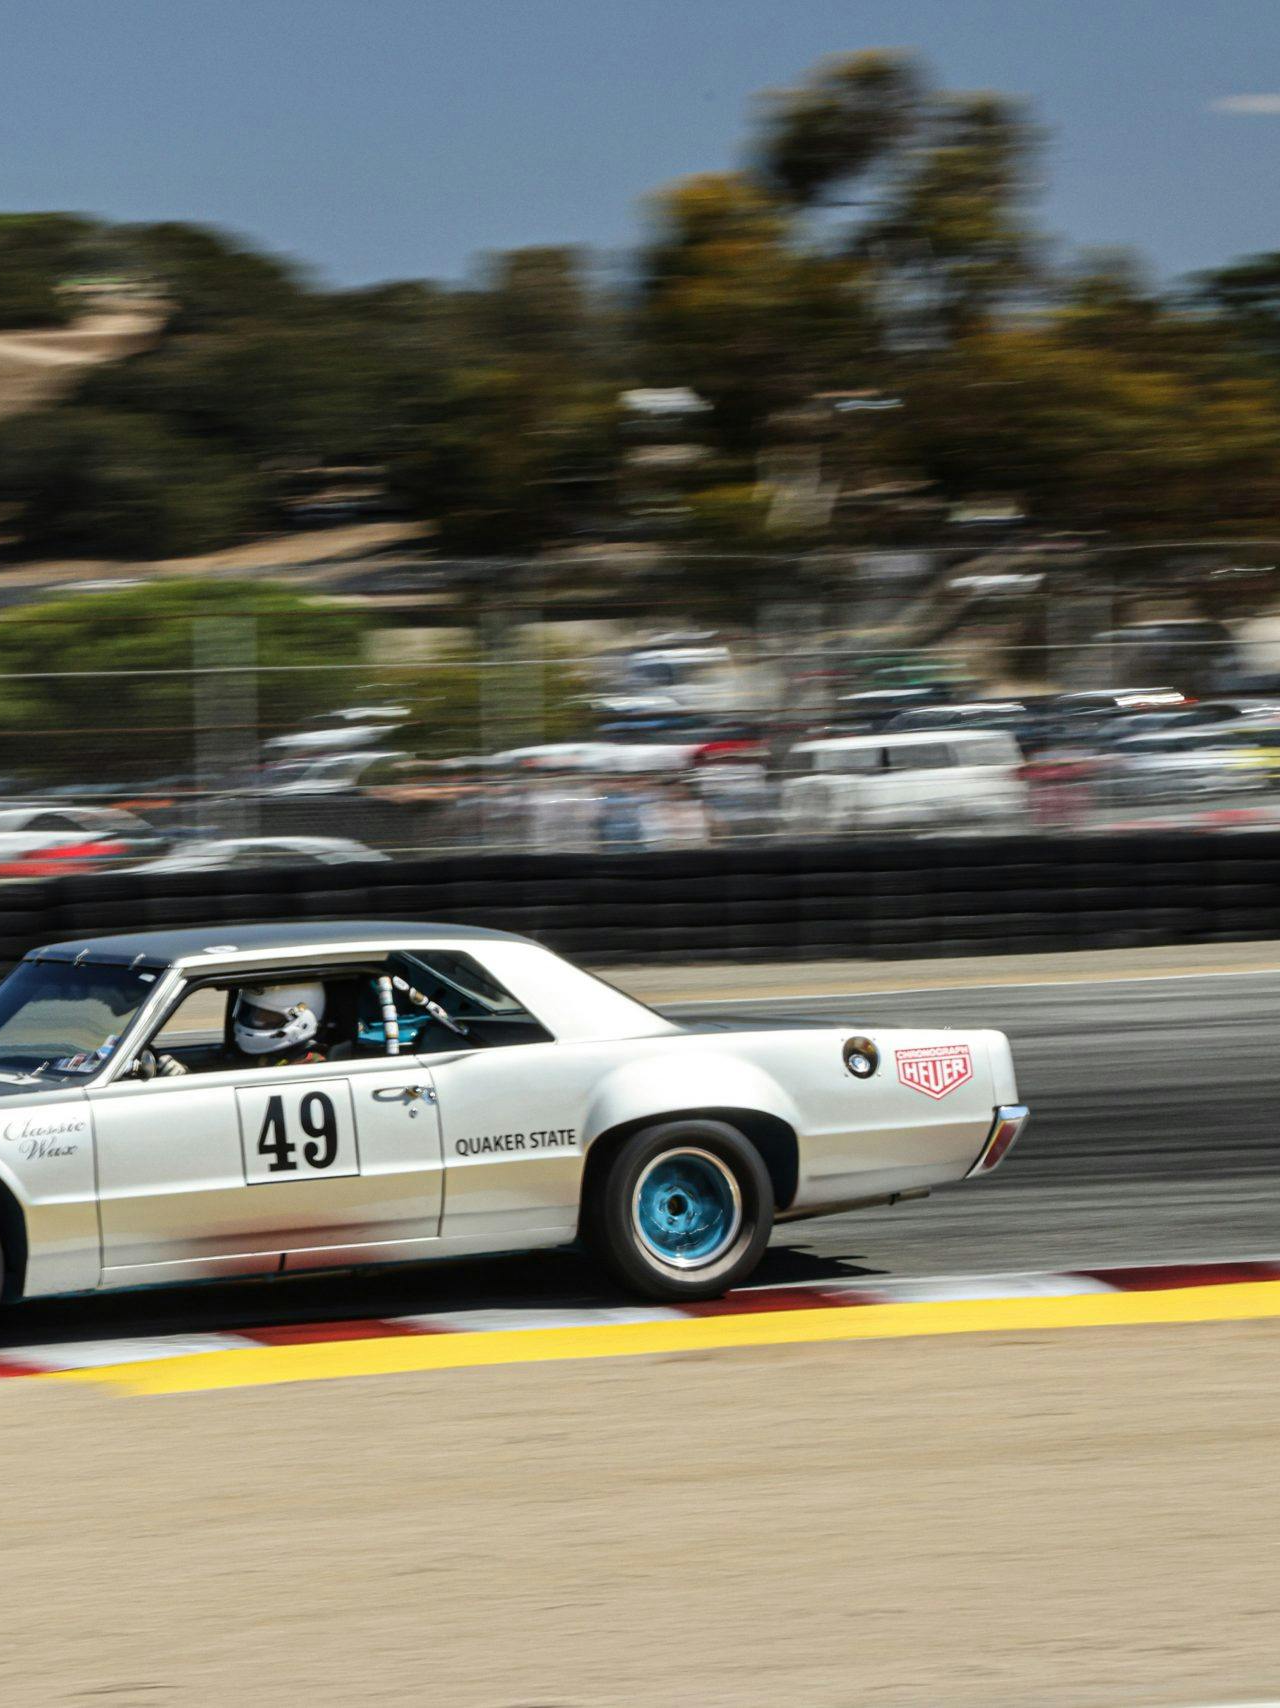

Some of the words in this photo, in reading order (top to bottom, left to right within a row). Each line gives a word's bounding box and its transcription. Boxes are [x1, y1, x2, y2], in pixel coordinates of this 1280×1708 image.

[903, 1059, 967, 1091] HEUER
[3, 1117, 86, 1141] Classic
[258, 1091, 338, 1172] 49
[455, 1133, 526, 1156] QUAKER
[529, 1129, 577, 1149] STATE
[19, 1137, 78, 1160] Wax
